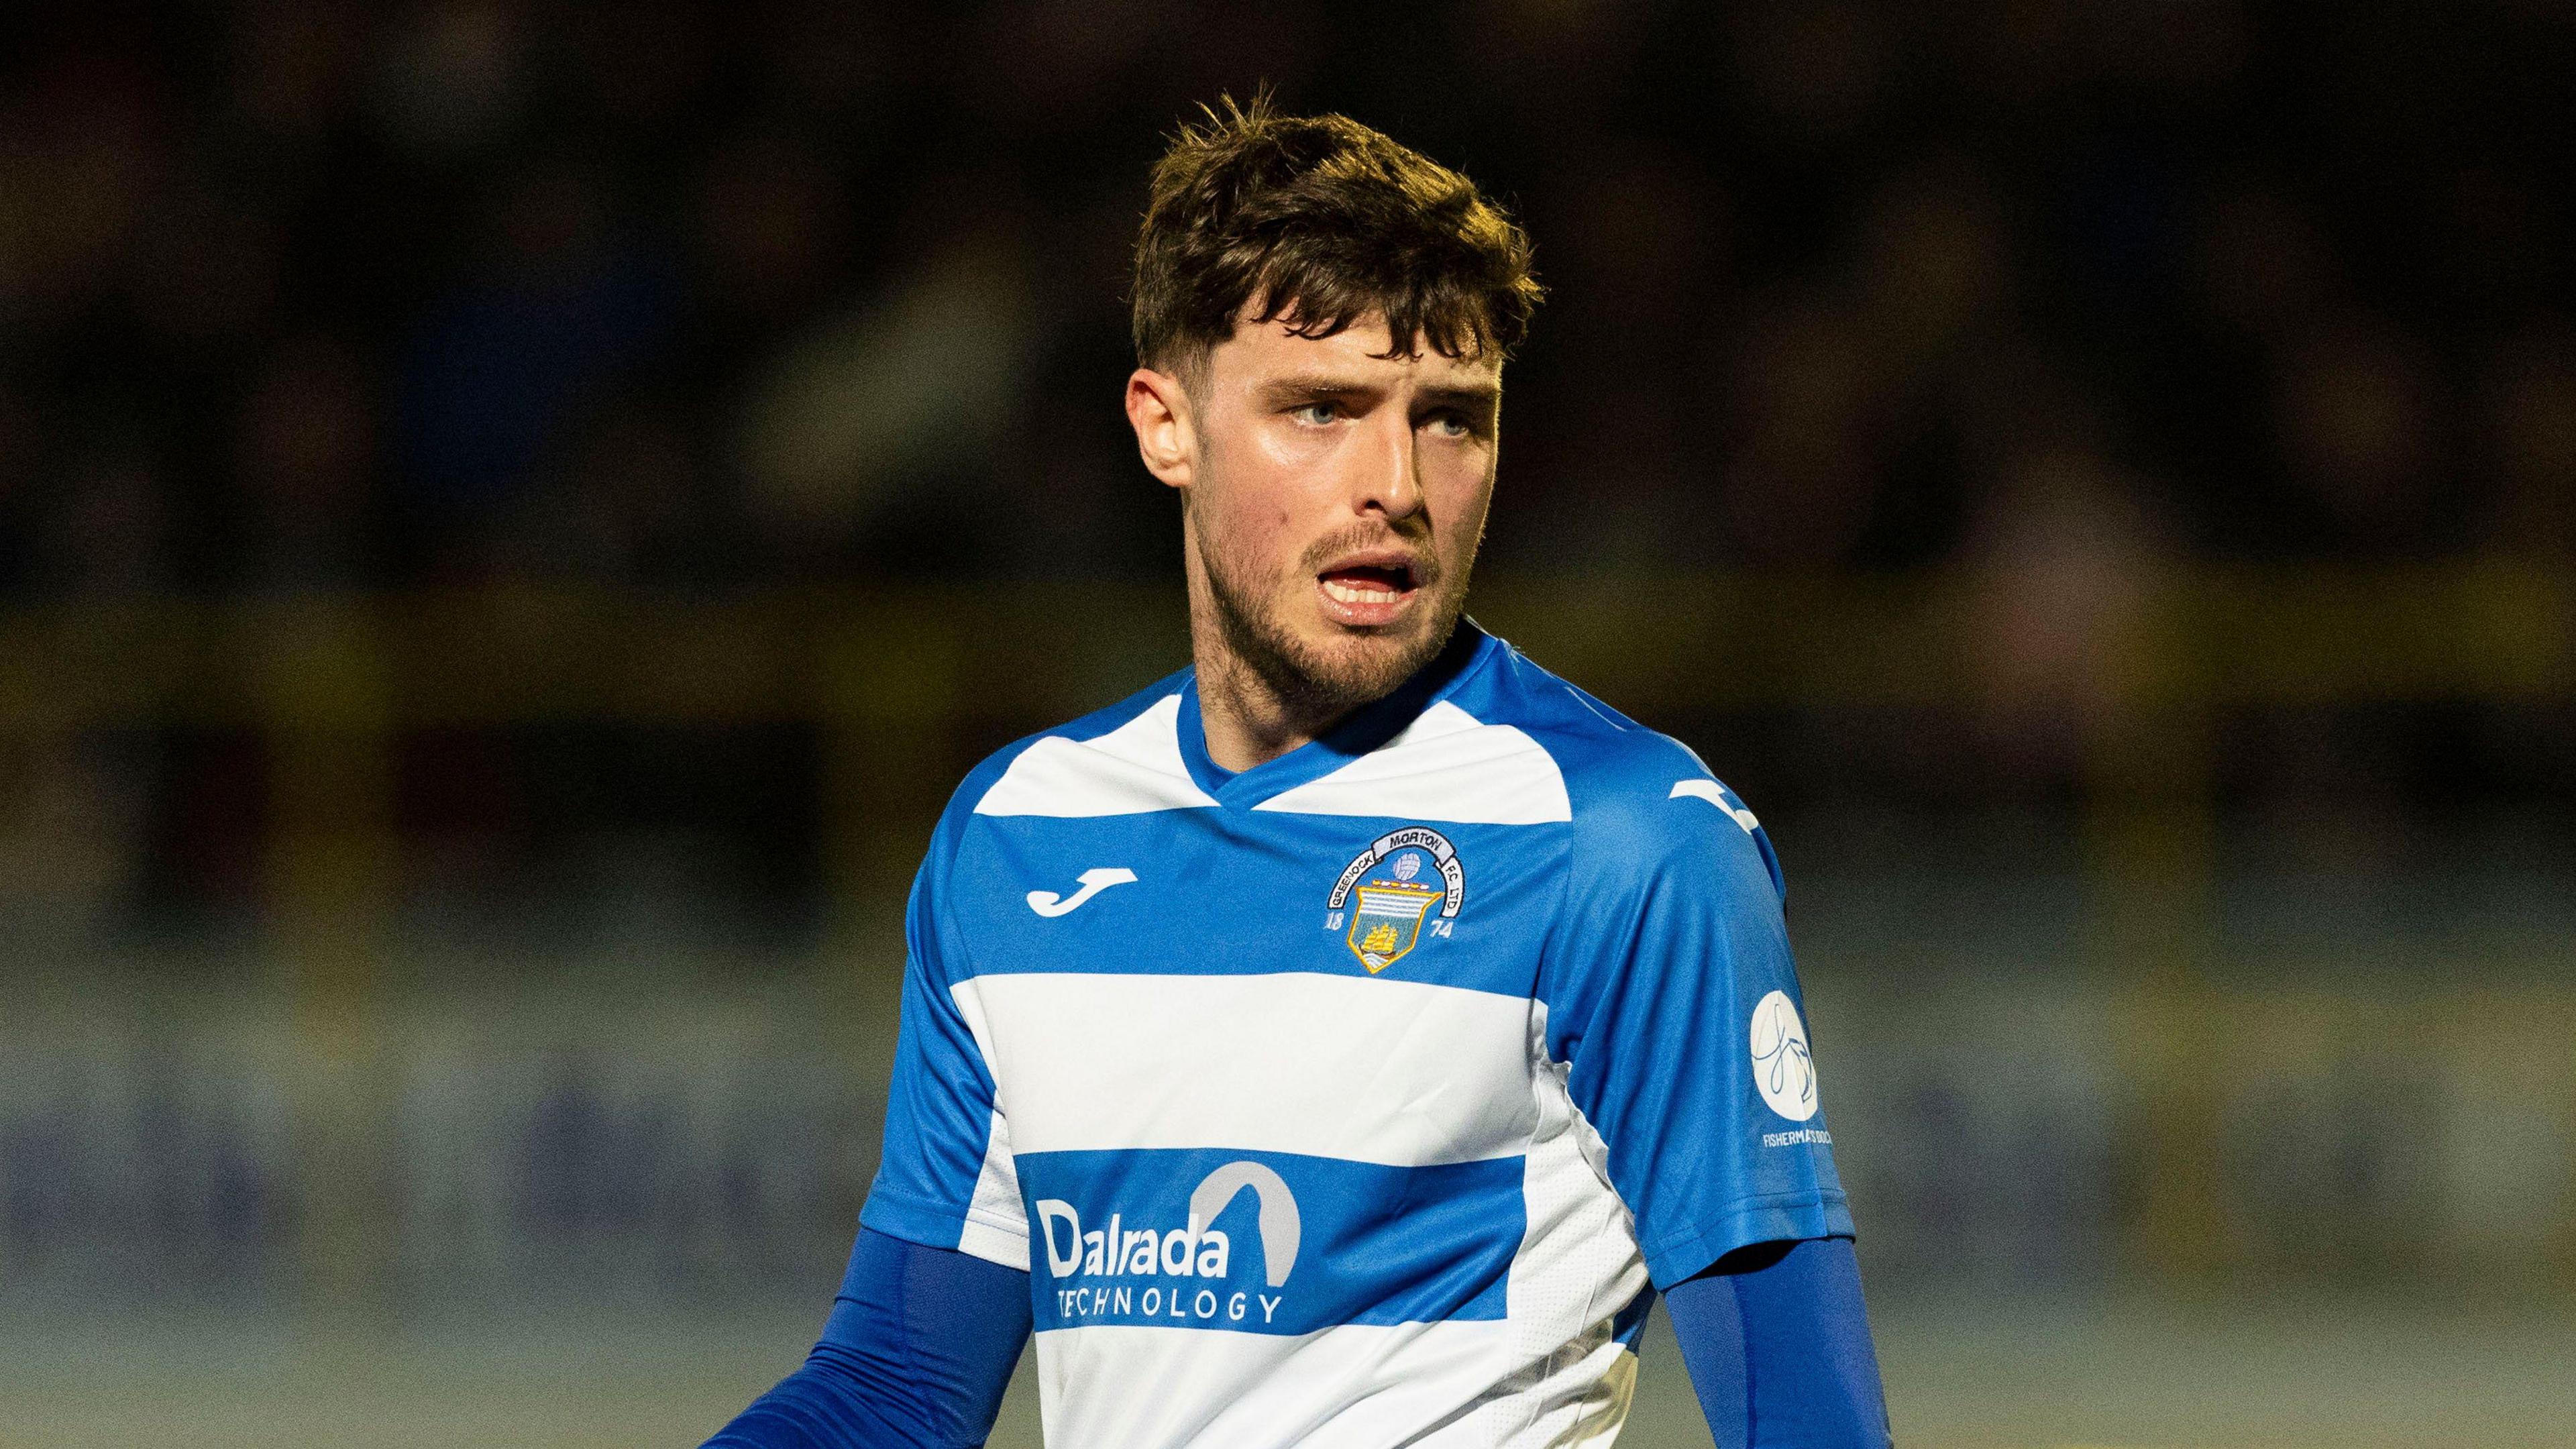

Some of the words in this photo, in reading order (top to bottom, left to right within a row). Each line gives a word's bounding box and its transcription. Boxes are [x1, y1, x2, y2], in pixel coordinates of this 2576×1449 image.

[1332, 854, 1373, 906] GREENOCK
[1389, 832, 1442, 851] MORTON
[1447, 888, 1460, 909] LTD
[1324, 912, 1344, 930] 18
[1430, 920, 1454, 938] 74
[1036, 1199, 1230, 1278] Dalrada
[1058, 1287, 1283, 1323] TECHNOLOGY
